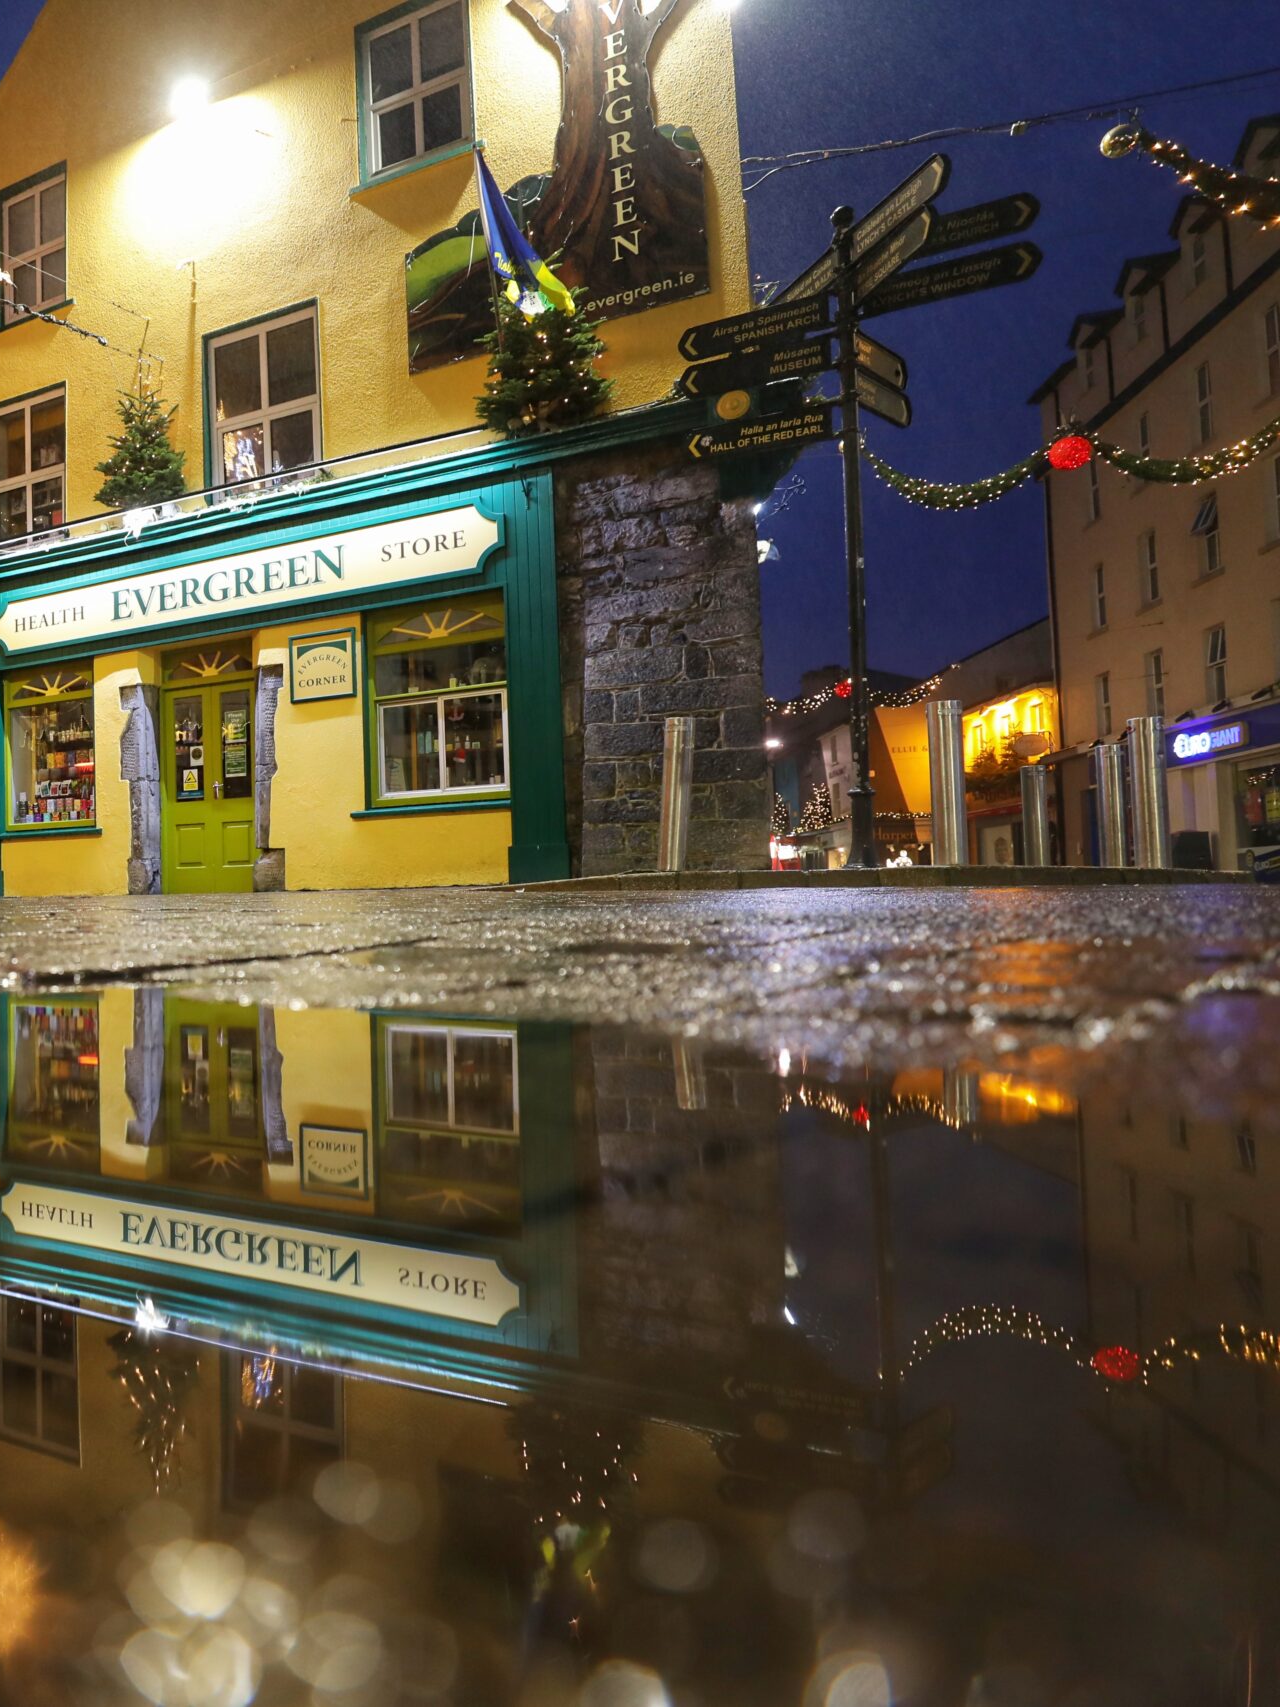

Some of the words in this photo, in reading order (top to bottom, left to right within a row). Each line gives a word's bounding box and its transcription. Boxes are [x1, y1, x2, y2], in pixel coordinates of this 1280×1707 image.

[856, 222, 887, 254] LYNCH'S
[887, 196, 918, 226] CASTLE
[874, 253, 902, 280] SQUARE
[930, 271, 992, 295] WINDOW
[733, 324, 785, 344] SPANISH
[786, 313, 821, 330] ARCH
[741, 320, 755, 331] na
[773, 344, 822, 362] Músaem
[770, 355, 823, 375] MUSEUM
[740, 423, 764, 436] Halla
[765, 422, 779, 432] an
[804, 413, 824, 424] Rua
[710, 440, 736, 453] HALL
[737, 437, 751, 448] OF
[751, 433, 772, 446] THE
[773, 429, 795, 441] RED
[795, 424, 824, 437] EARL
[14, 605, 86, 633] HEALTH
[110, 544, 345, 622] EVERGREEN
[380, 529, 467, 563] STORE
[297, 653, 348, 676] EVERGREEN
[298, 674, 347, 689] CORNER
[891, 745, 918, 754] ELLIE
